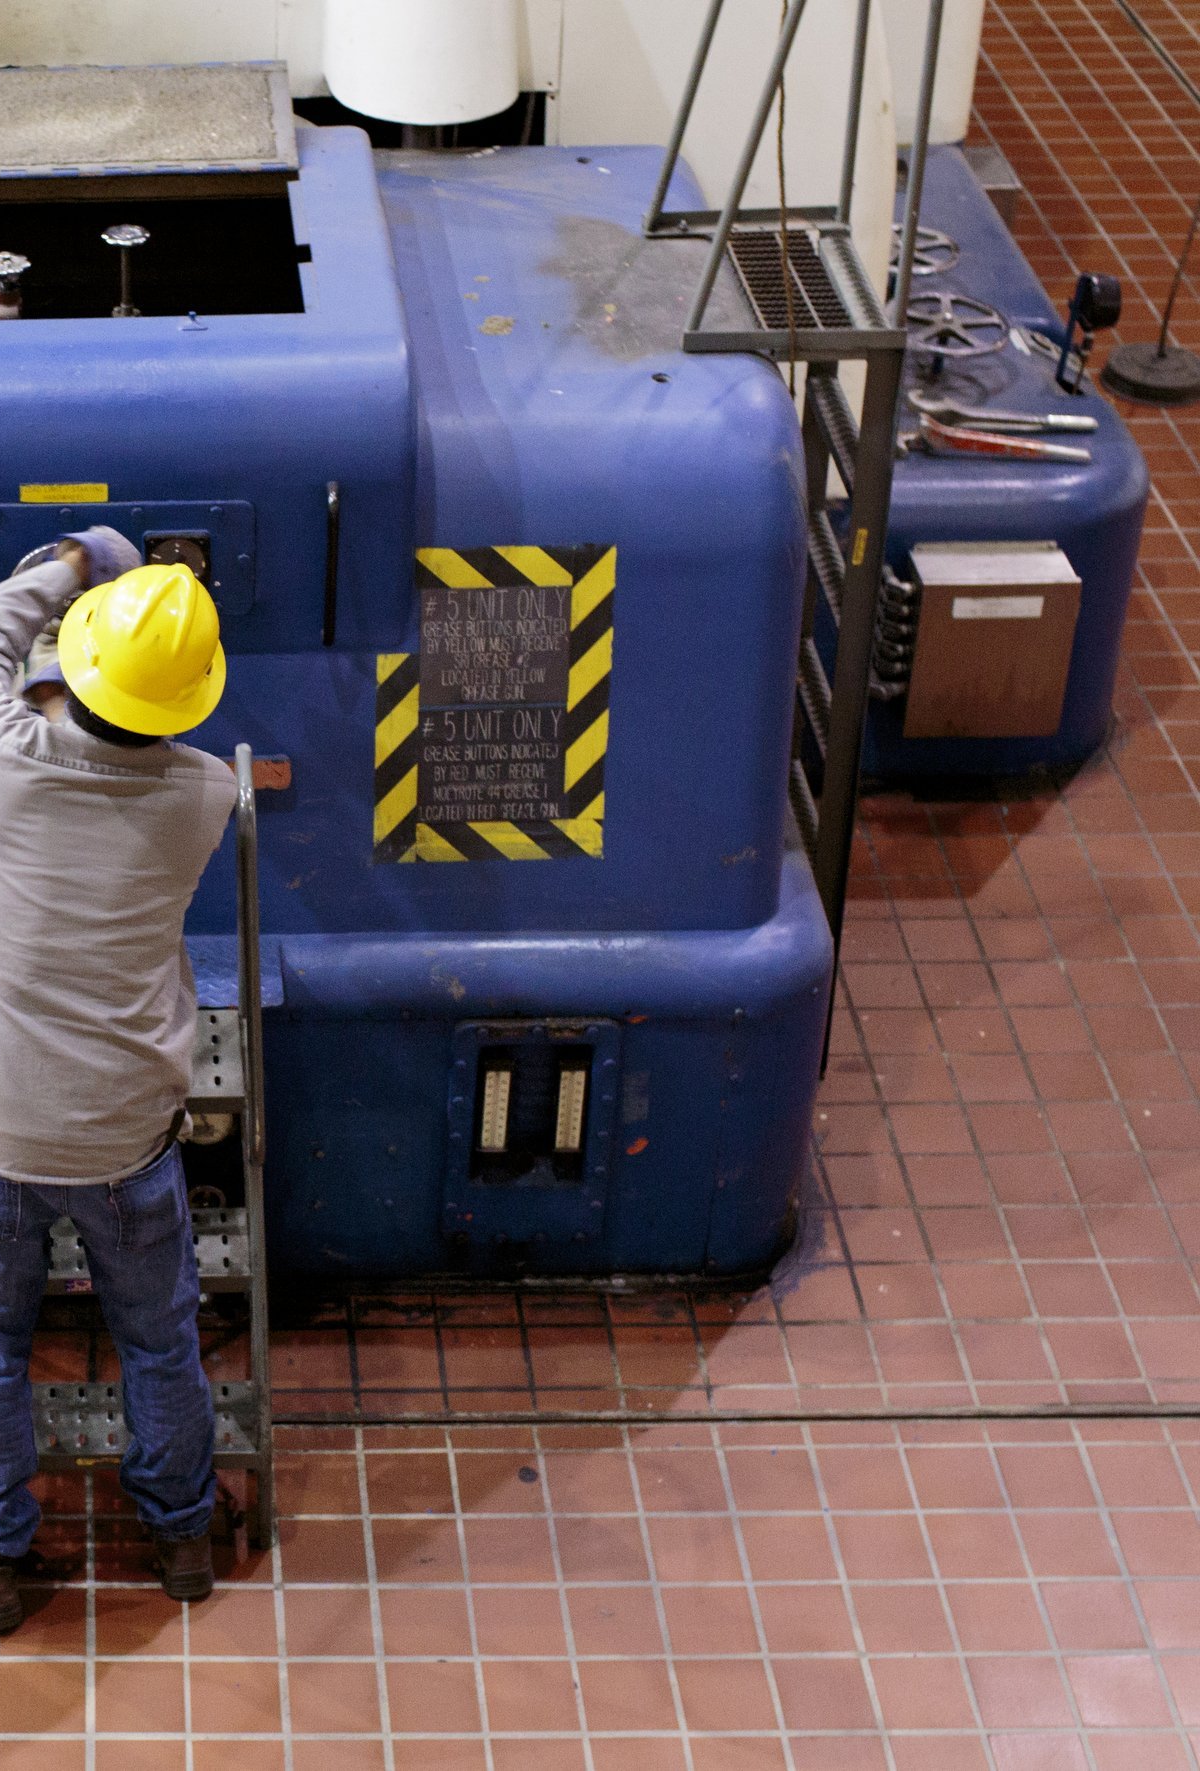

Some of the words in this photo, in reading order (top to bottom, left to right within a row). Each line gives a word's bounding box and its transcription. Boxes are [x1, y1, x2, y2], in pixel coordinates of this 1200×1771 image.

[447, 590, 459, 621] 5
[467, 589, 508, 620] UNIT
[518, 588, 567, 619] ONLY
[423, 621, 462, 638] GREASE
[466, 620, 513, 637] BUTTONS
[516, 616, 567, 635] INDICATED
[427, 638, 439, 654] BY
[445, 637, 486, 653] YELLOW
[489, 637, 517, 653] MUST
[521, 635, 560, 652] RECEIVE
[473, 652, 512, 668] GREASE
[441, 669, 488, 686] LOCATED
[505, 668, 546, 684] YELLOW
[461, 686, 499, 700] GREASE
[444, 711, 456, 741] 5
[464, 710, 504, 740] UNIT
[513, 709, 562, 739] ONLY
[423, 746, 460, 762] GREASE
[464, 744, 509, 760] BUTTONS
[511, 743, 559, 760] INDICATED
[433, 766, 446, 782] BY
[449, 765, 469, 781] RED
[475, 764, 501, 780] MUST
[508, 763, 546, 780] RECEIVE
[502, 783, 540, 800] GREASE
[418, 805, 464, 821] LOCATED
[502, 803, 537, 819] GREASE
